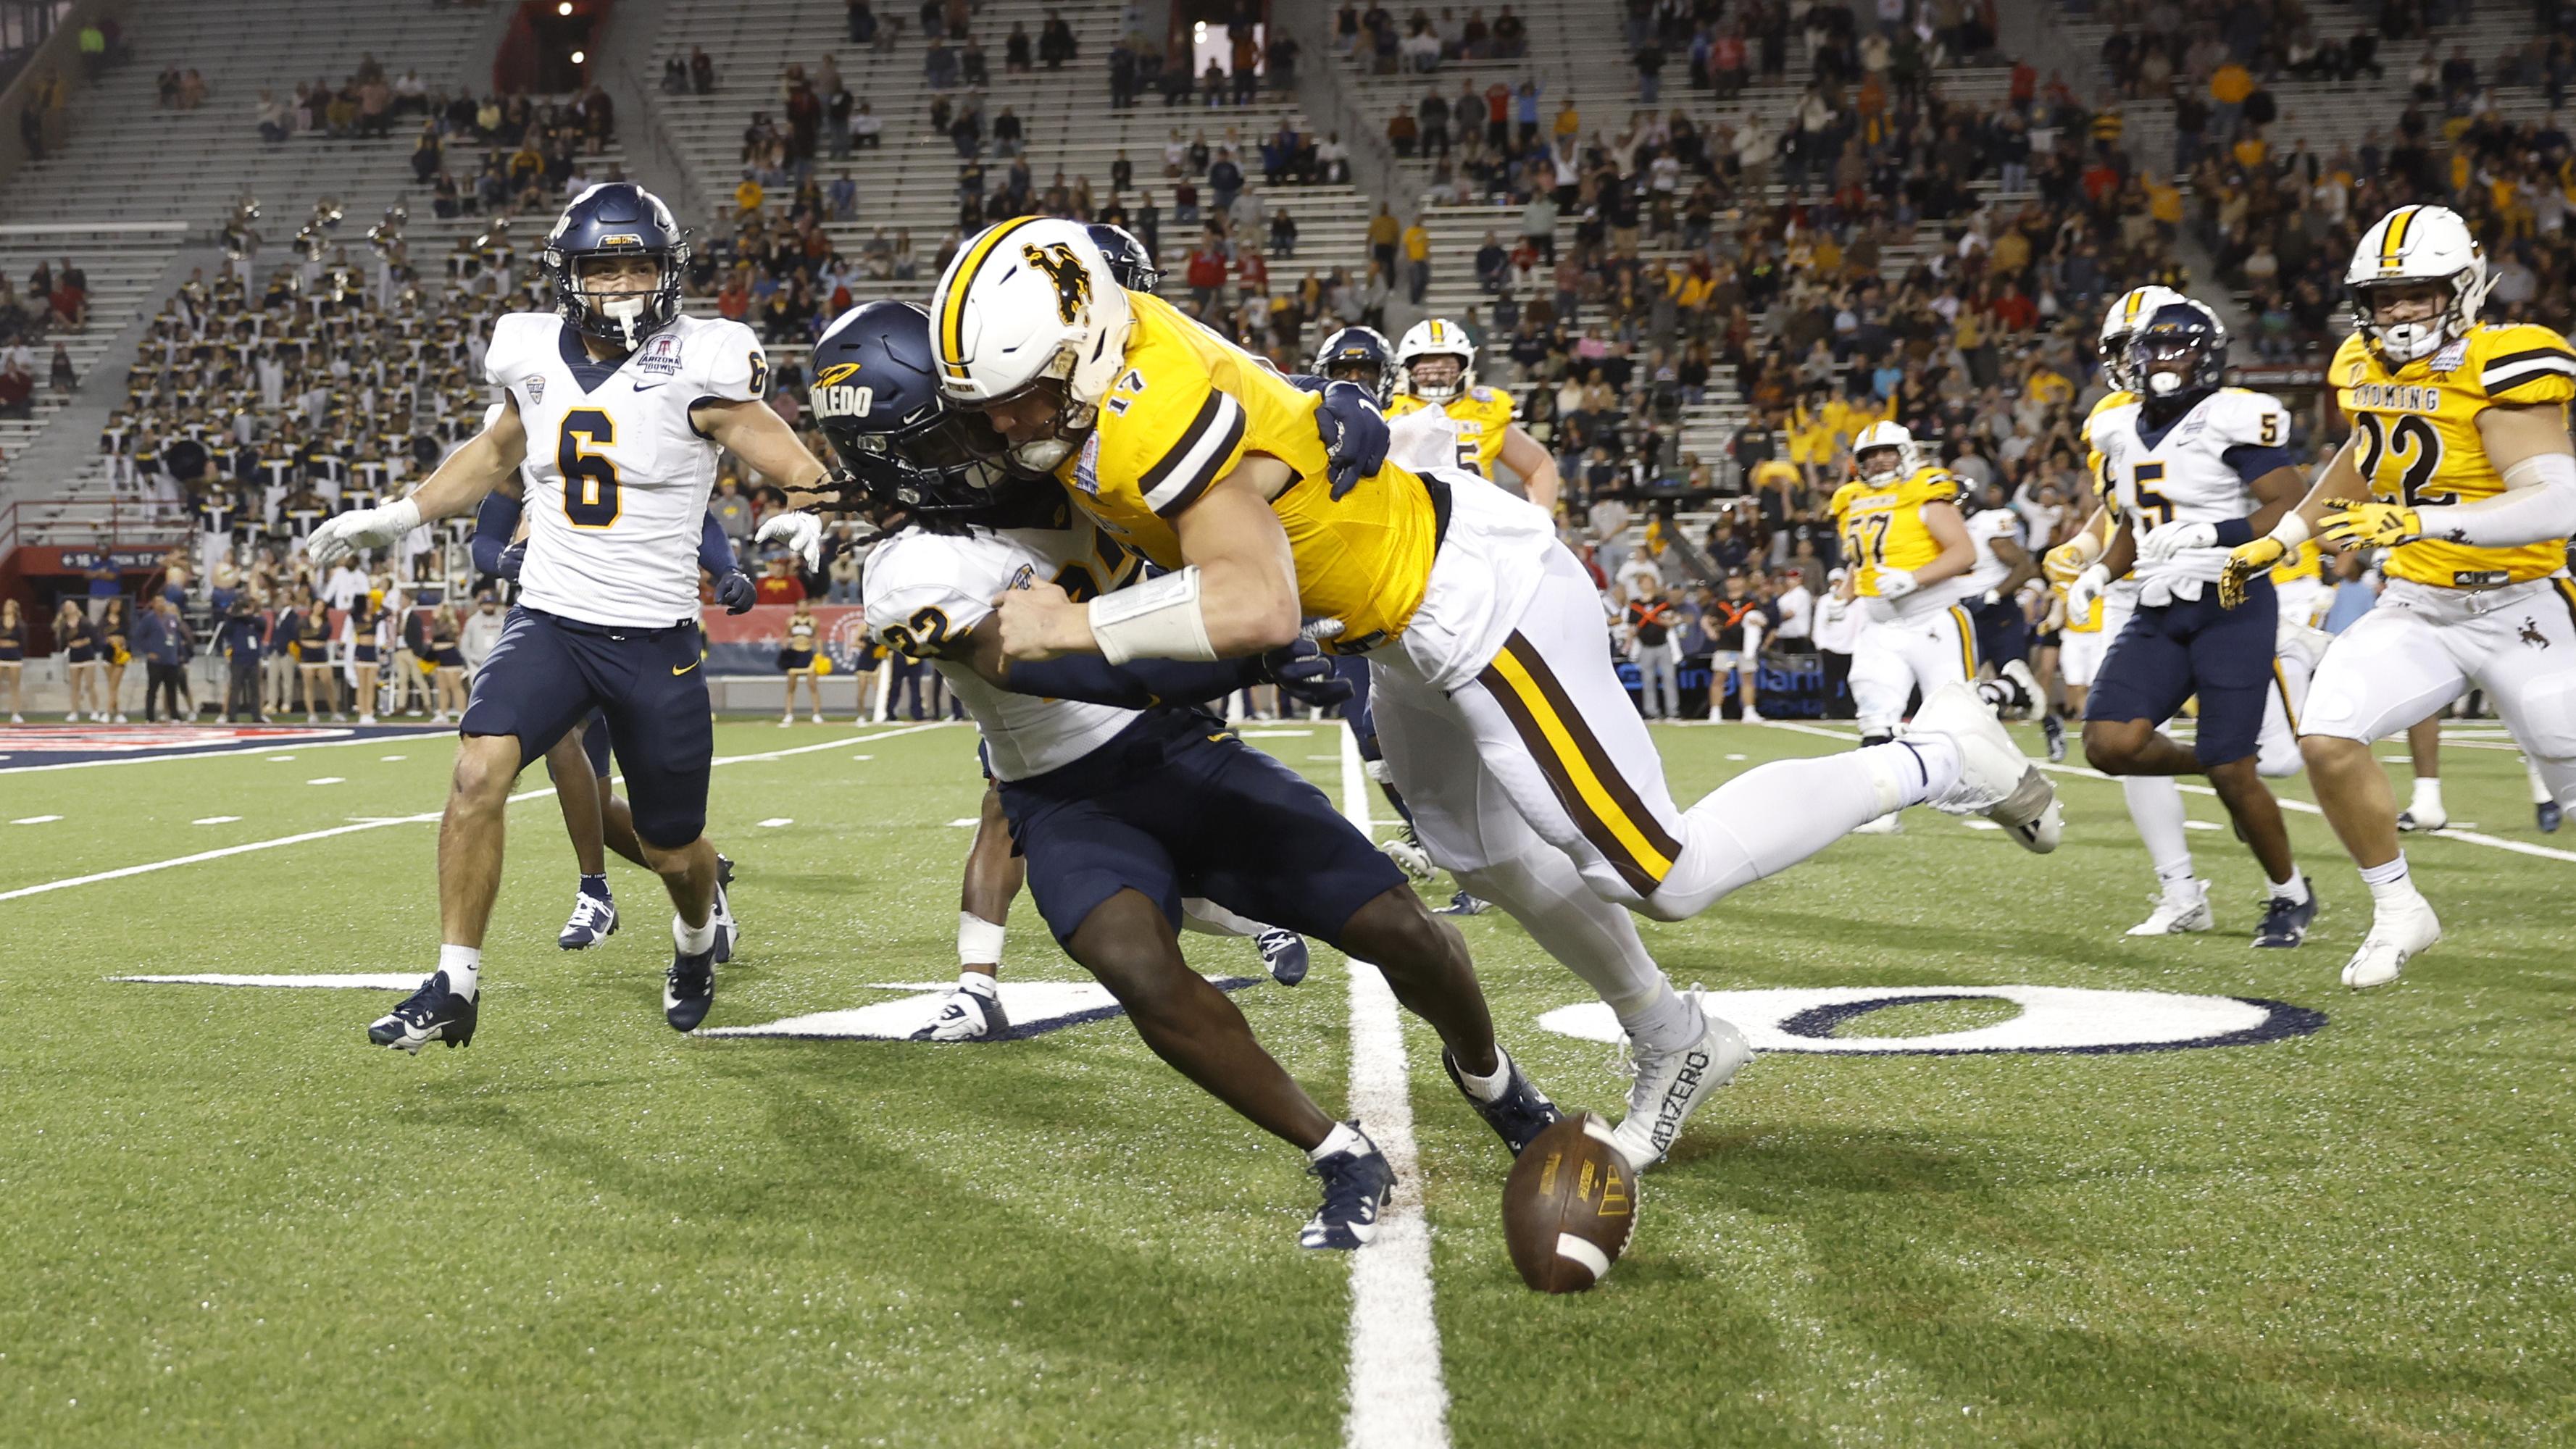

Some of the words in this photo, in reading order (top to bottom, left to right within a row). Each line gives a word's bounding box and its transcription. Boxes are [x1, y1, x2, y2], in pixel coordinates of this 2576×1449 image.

[642, 356, 680, 367] ARIZONA
[648, 364, 672, 372] BOWL
[809, 385, 873, 422] TOLEDO
[1106, 368, 1147, 418] 17
[2261, 413, 2277, 447] 5
[555, 406, 622, 530] 6
[2355, 409, 2462, 508] 22
[2134, 461, 2177, 533] 5
[1846, 510, 1893, 569] 57
[1651, 1051, 1709, 1153] ADIZERO
